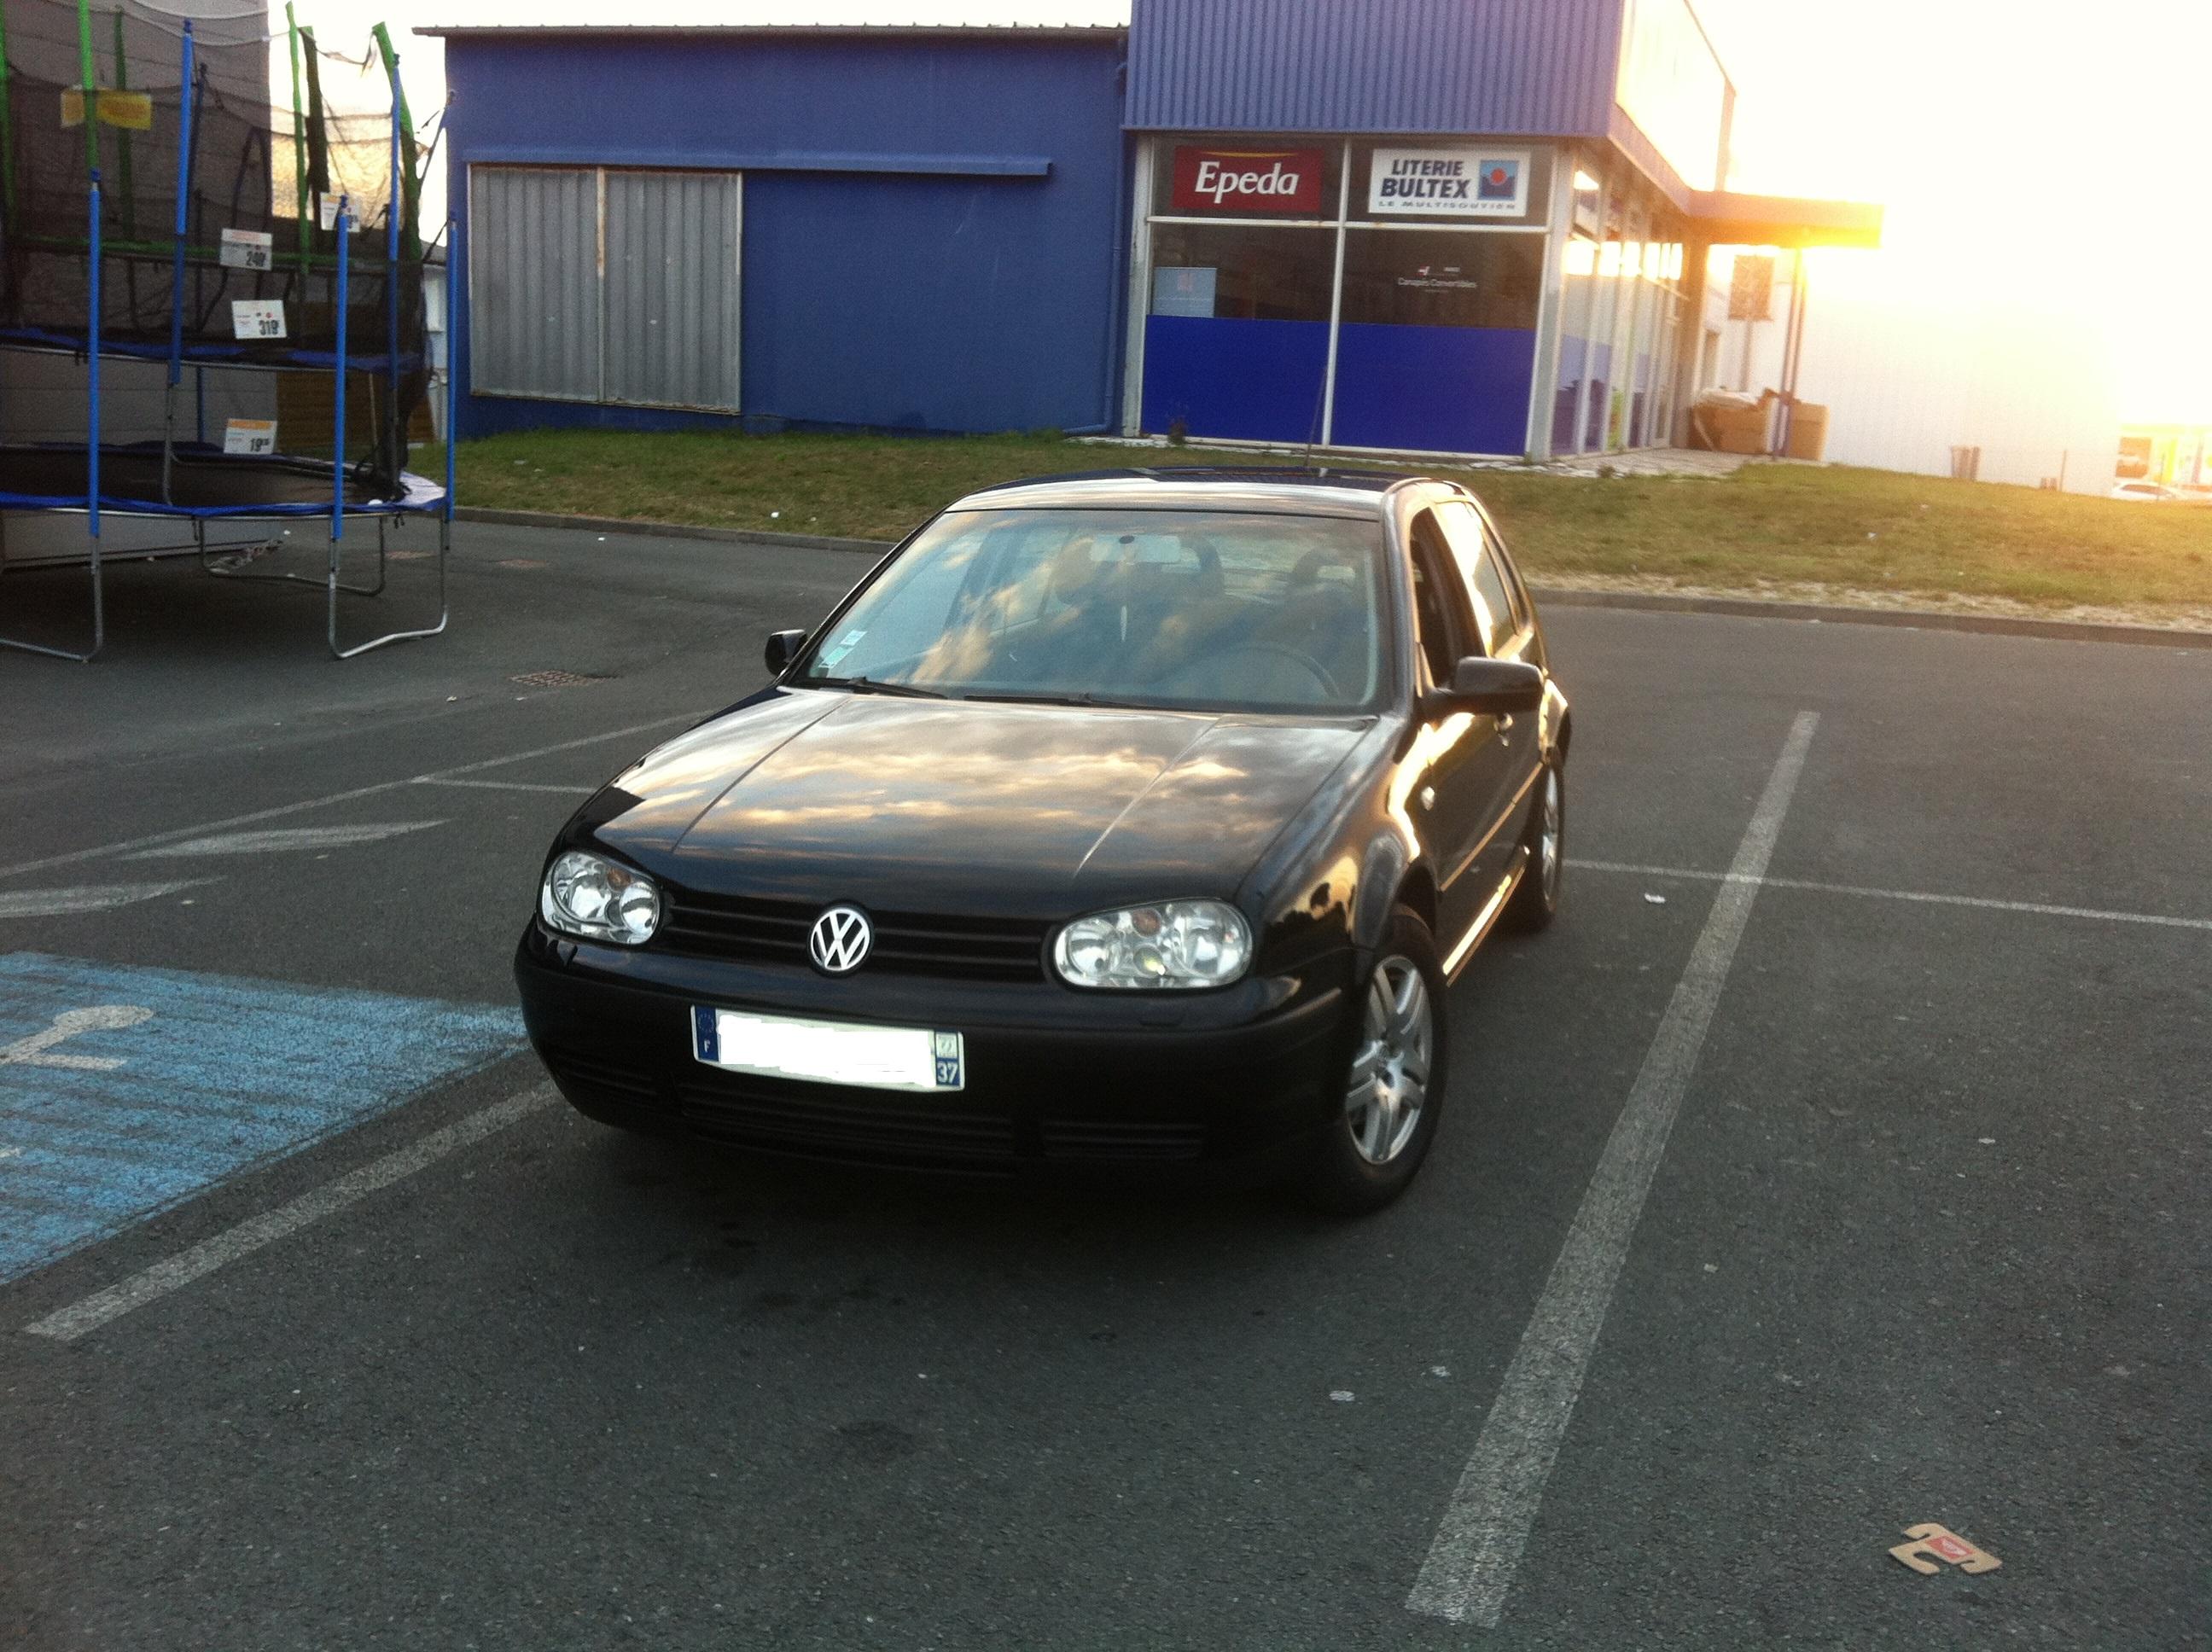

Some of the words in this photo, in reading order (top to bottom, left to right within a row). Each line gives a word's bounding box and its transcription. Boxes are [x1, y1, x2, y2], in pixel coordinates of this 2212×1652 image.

[1391, 159, 1464, 177] LITERIE
[1195, 160, 1300, 204] Epeda
[1380, 177, 1471, 199] BULTEX
[937, 1062, 958, 1084] 37
